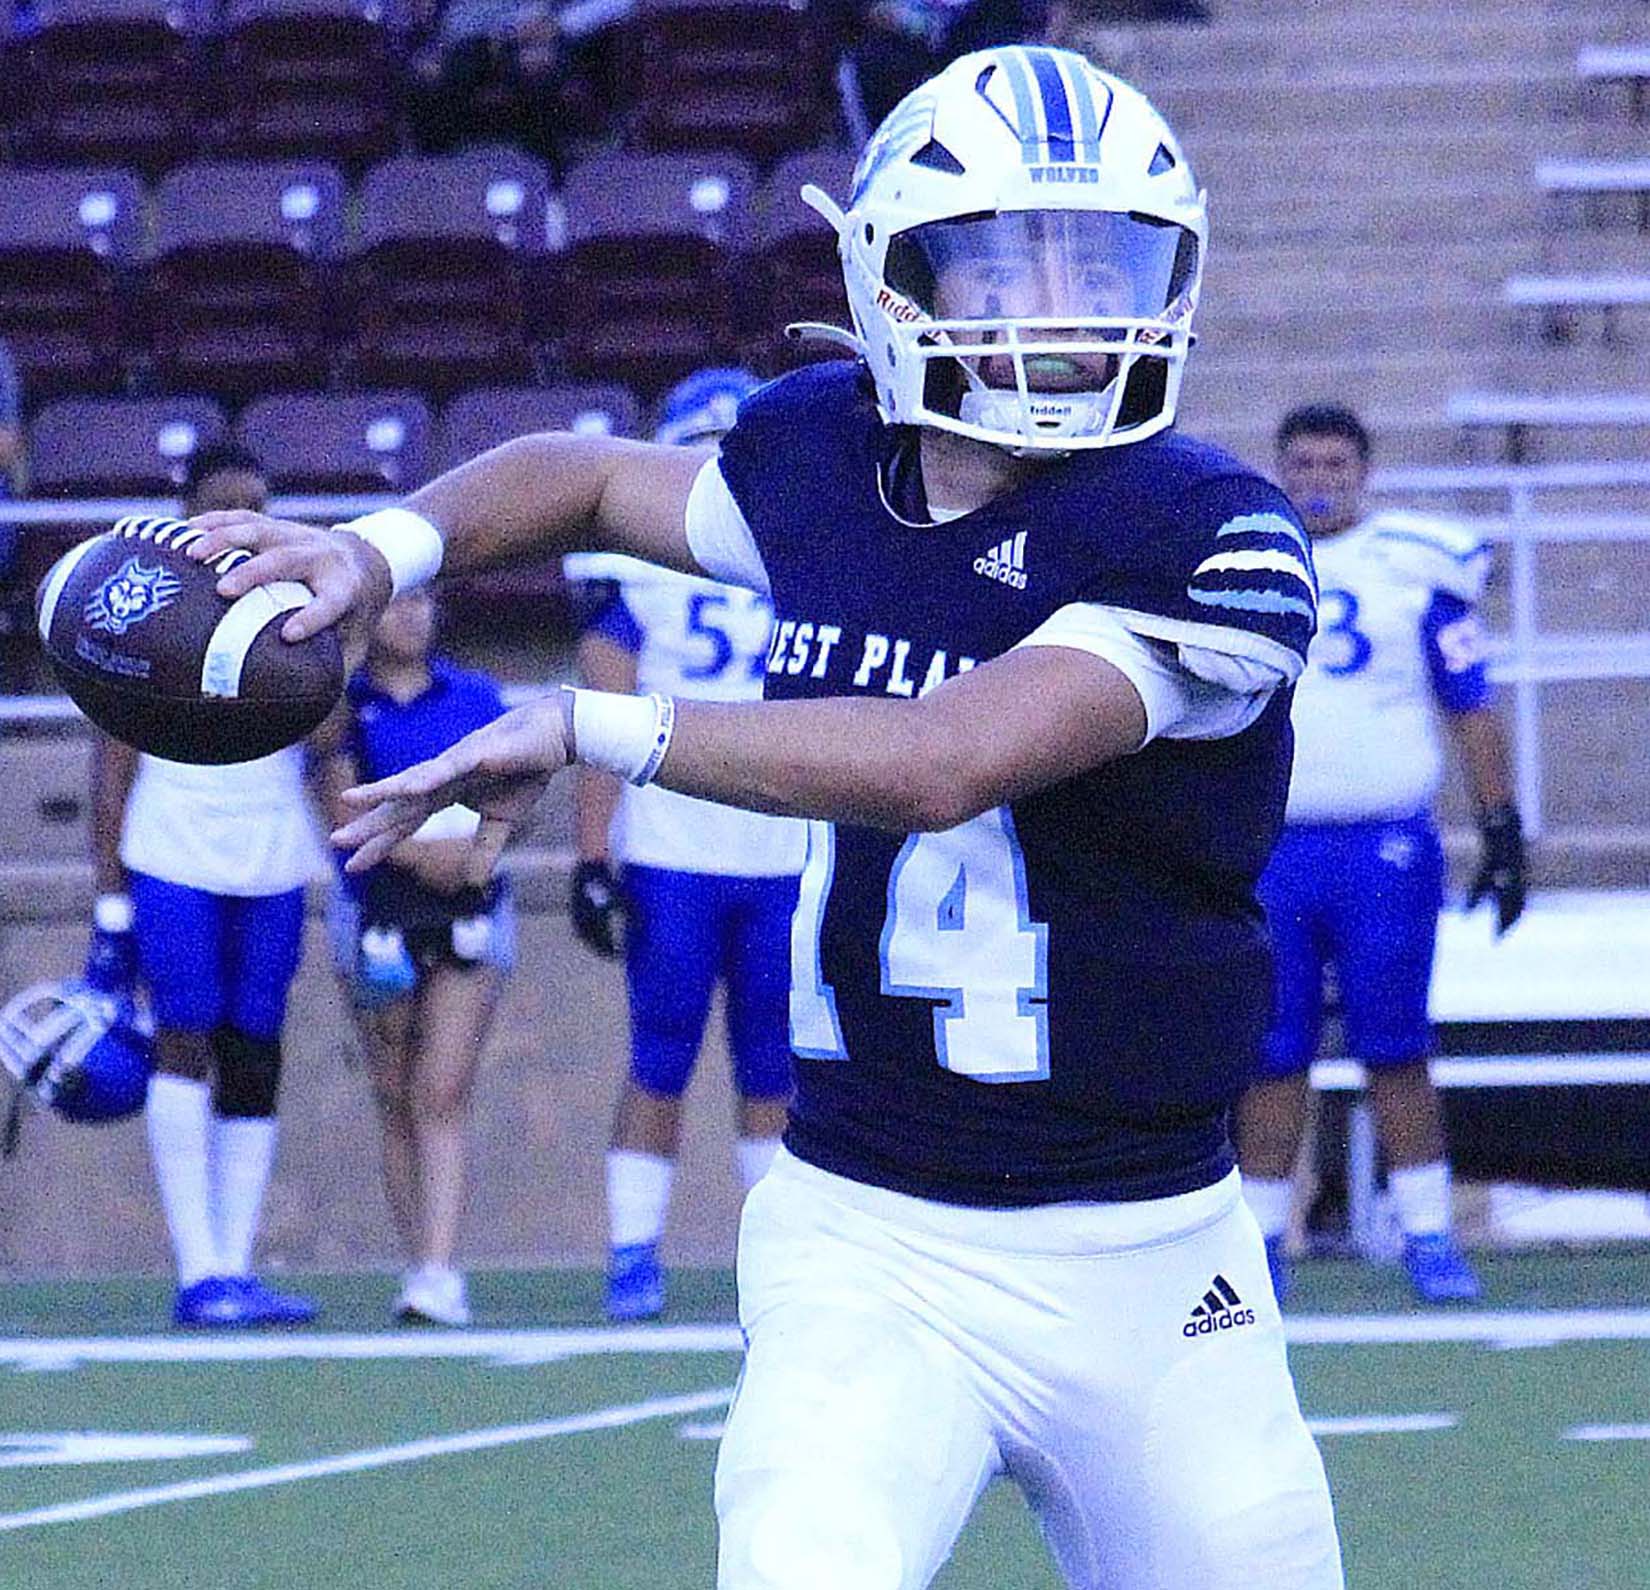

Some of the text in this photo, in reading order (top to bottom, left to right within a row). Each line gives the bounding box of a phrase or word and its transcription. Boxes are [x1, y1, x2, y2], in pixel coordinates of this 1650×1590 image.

[1029, 166, 1099, 184] WOLVES
[973, 557, 1028, 590] adidas
[767, 618, 986, 699] EST PLA
[788, 803, 1051, 1084] 14
[1183, 1308, 1255, 1337] adidas
